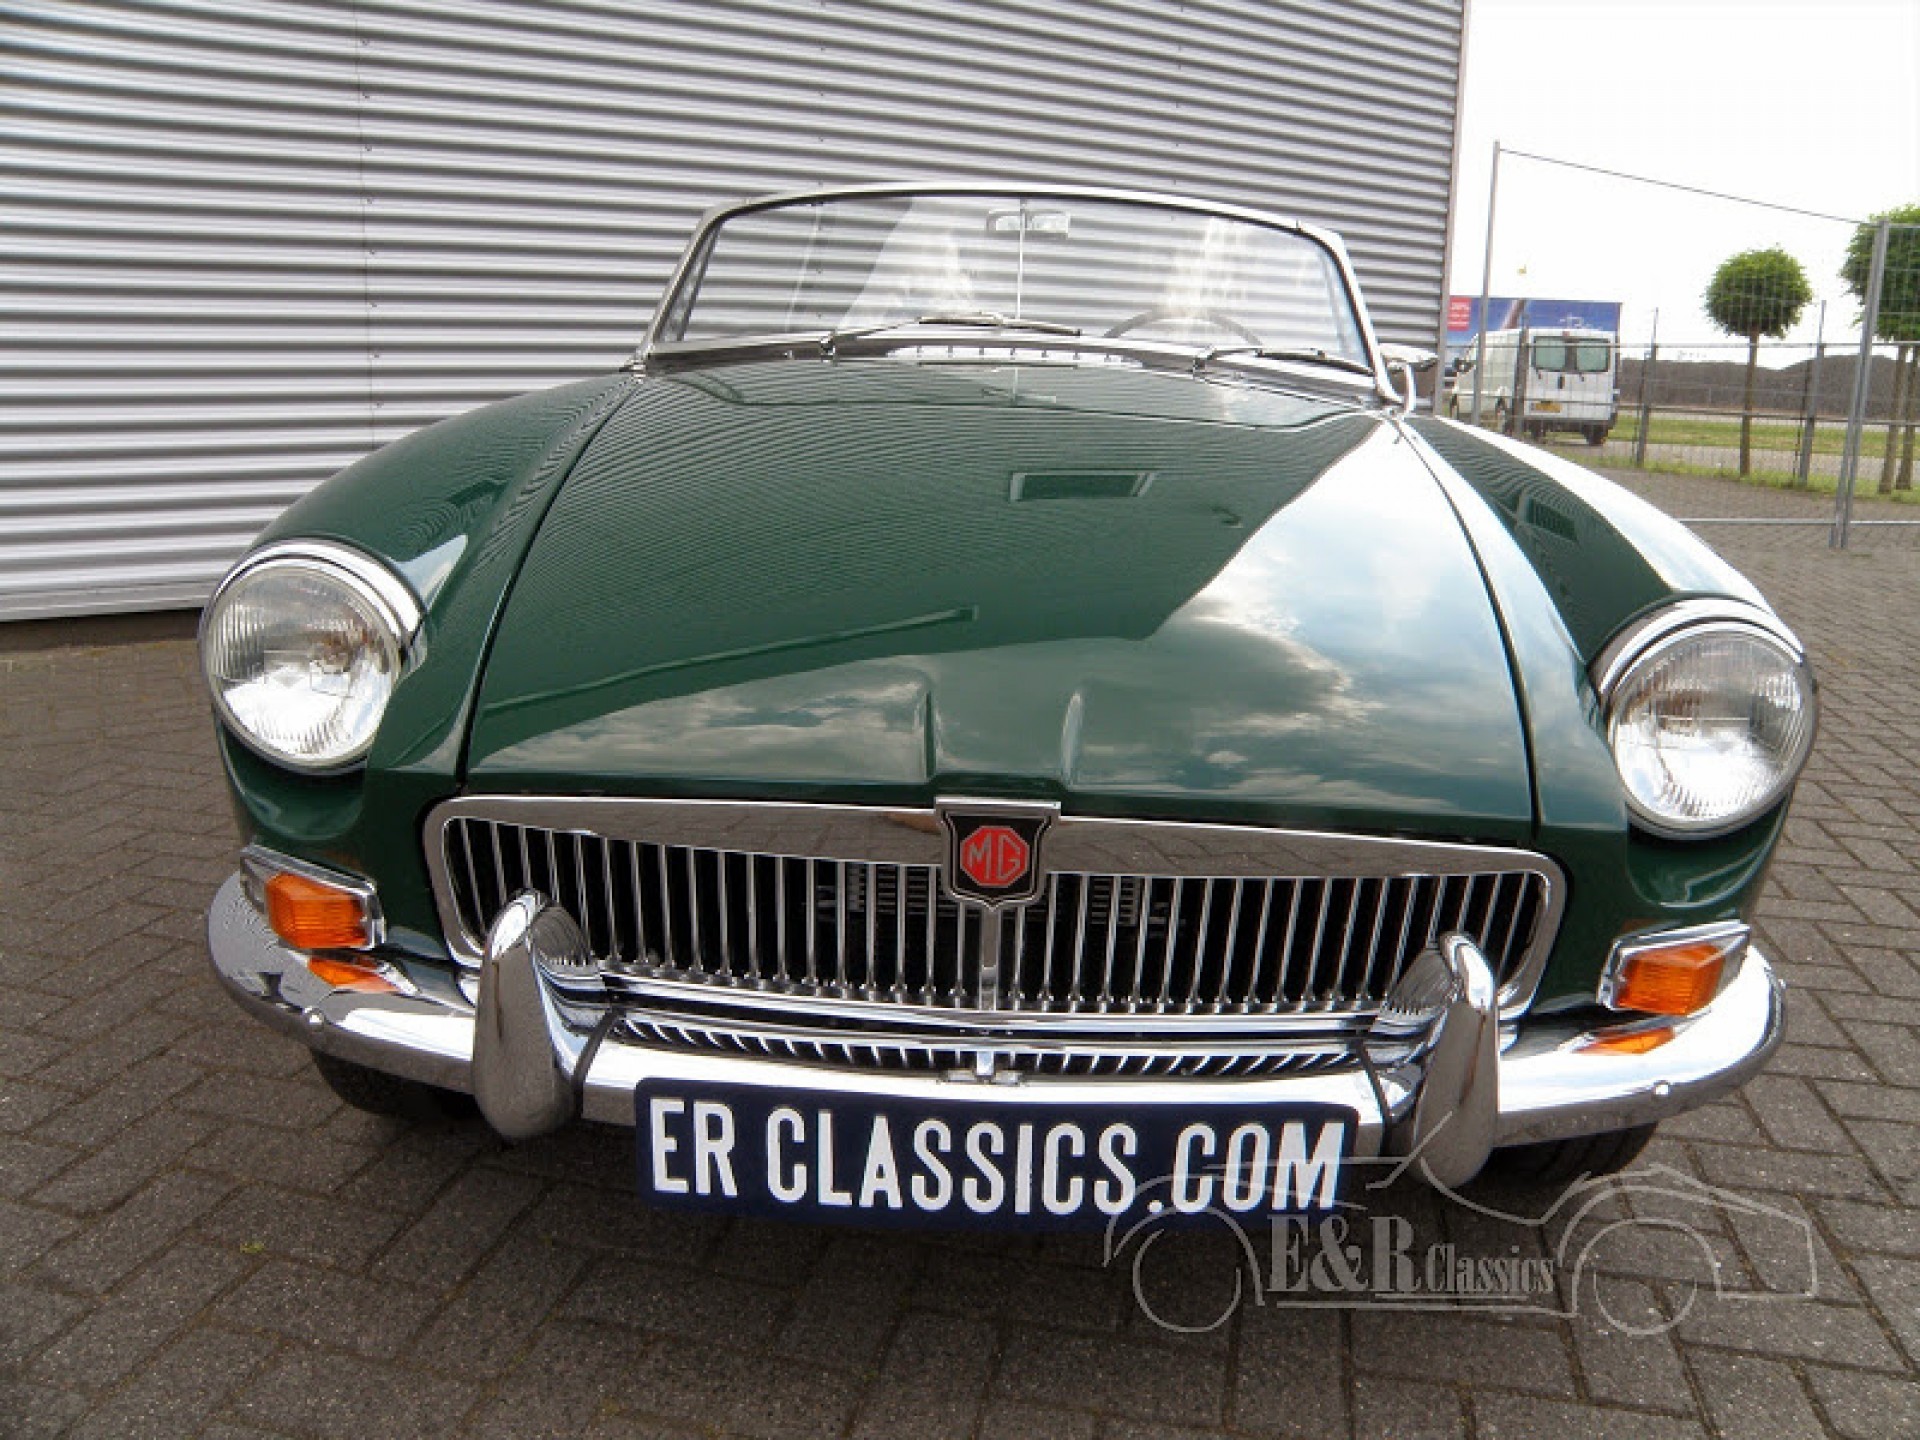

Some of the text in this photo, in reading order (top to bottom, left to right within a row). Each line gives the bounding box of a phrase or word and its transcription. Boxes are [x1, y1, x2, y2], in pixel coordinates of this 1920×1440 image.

[964, 829, 1024, 883] MG
[650, 1098, 1345, 1214] ER CLASSICS.COM
